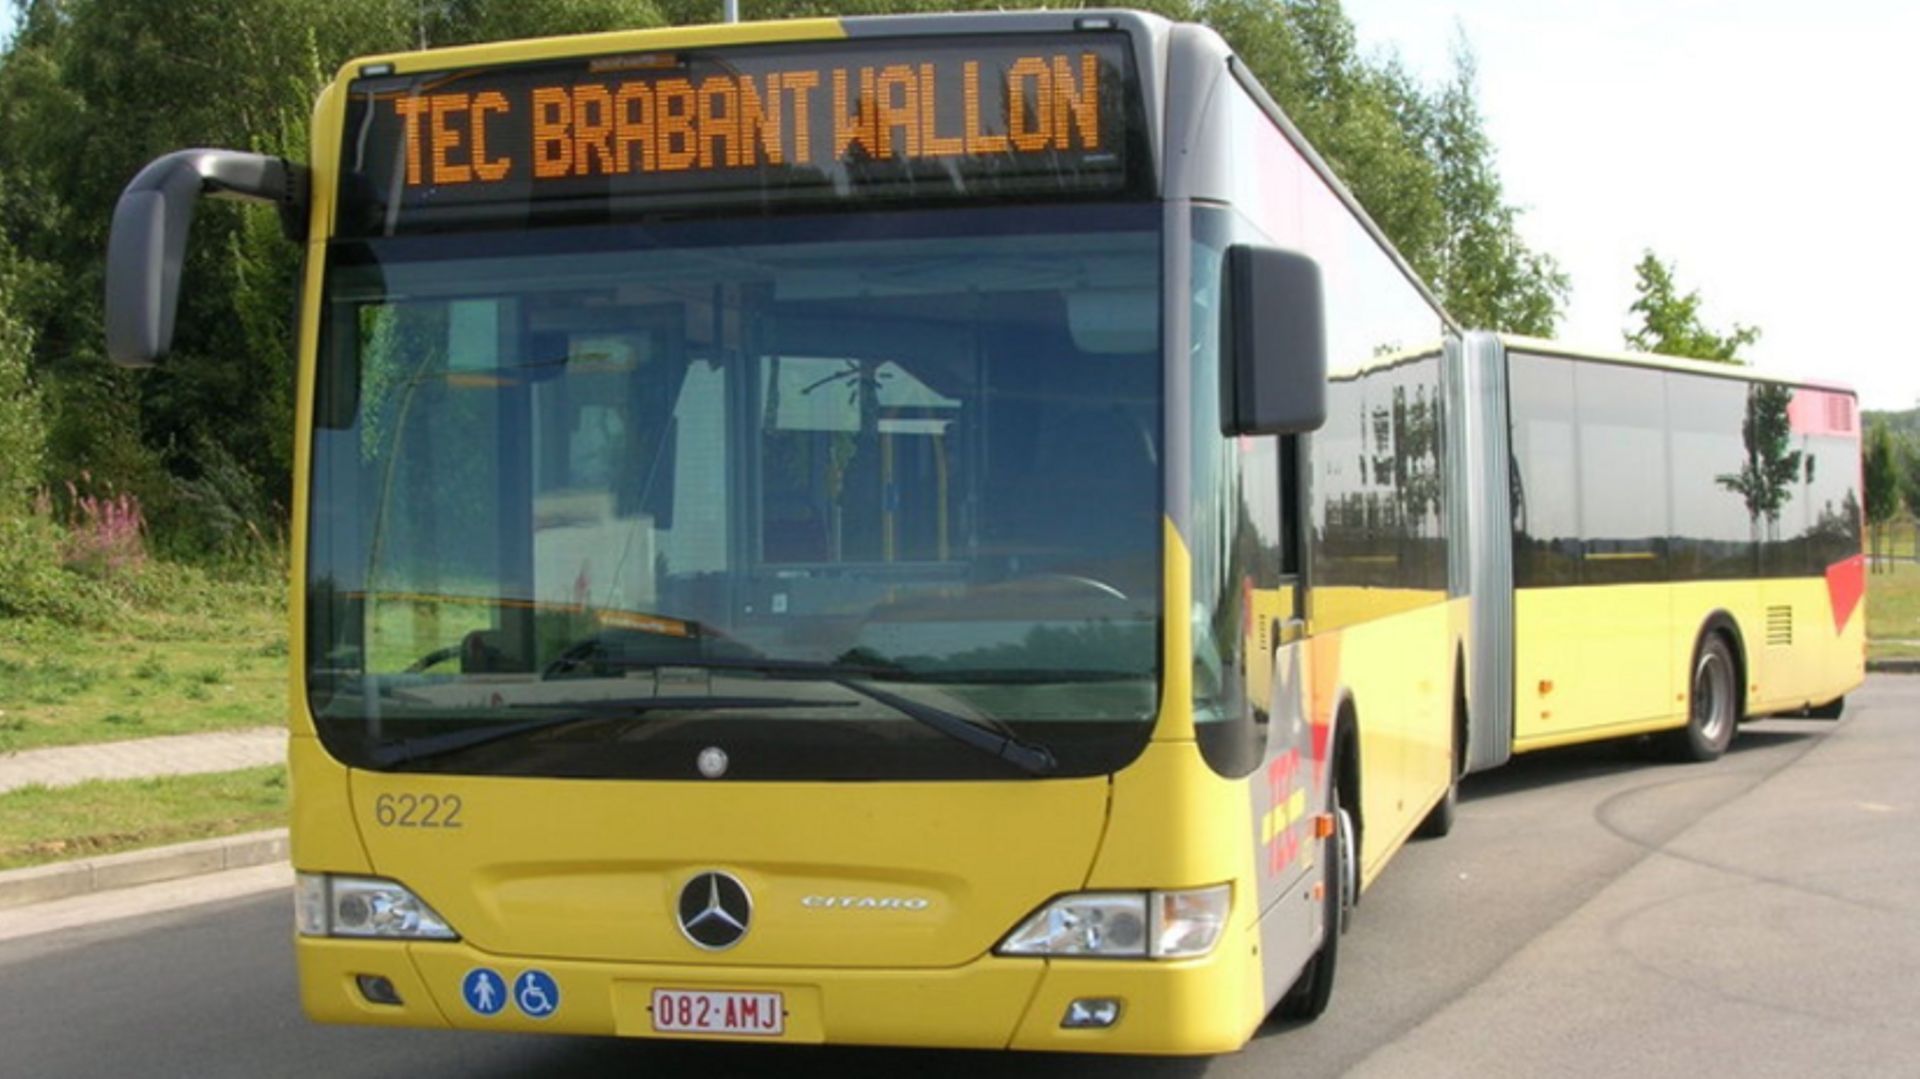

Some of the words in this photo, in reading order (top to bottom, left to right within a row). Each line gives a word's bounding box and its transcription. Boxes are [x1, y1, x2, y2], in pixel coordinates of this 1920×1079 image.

[395, 91, 511, 185] TEC
[532, 69, 820, 178] BRABANT
[832, 54, 1099, 161] WALLON
[374, 792, 463, 828] 6222
[801, 895, 930, 910] CITARO
